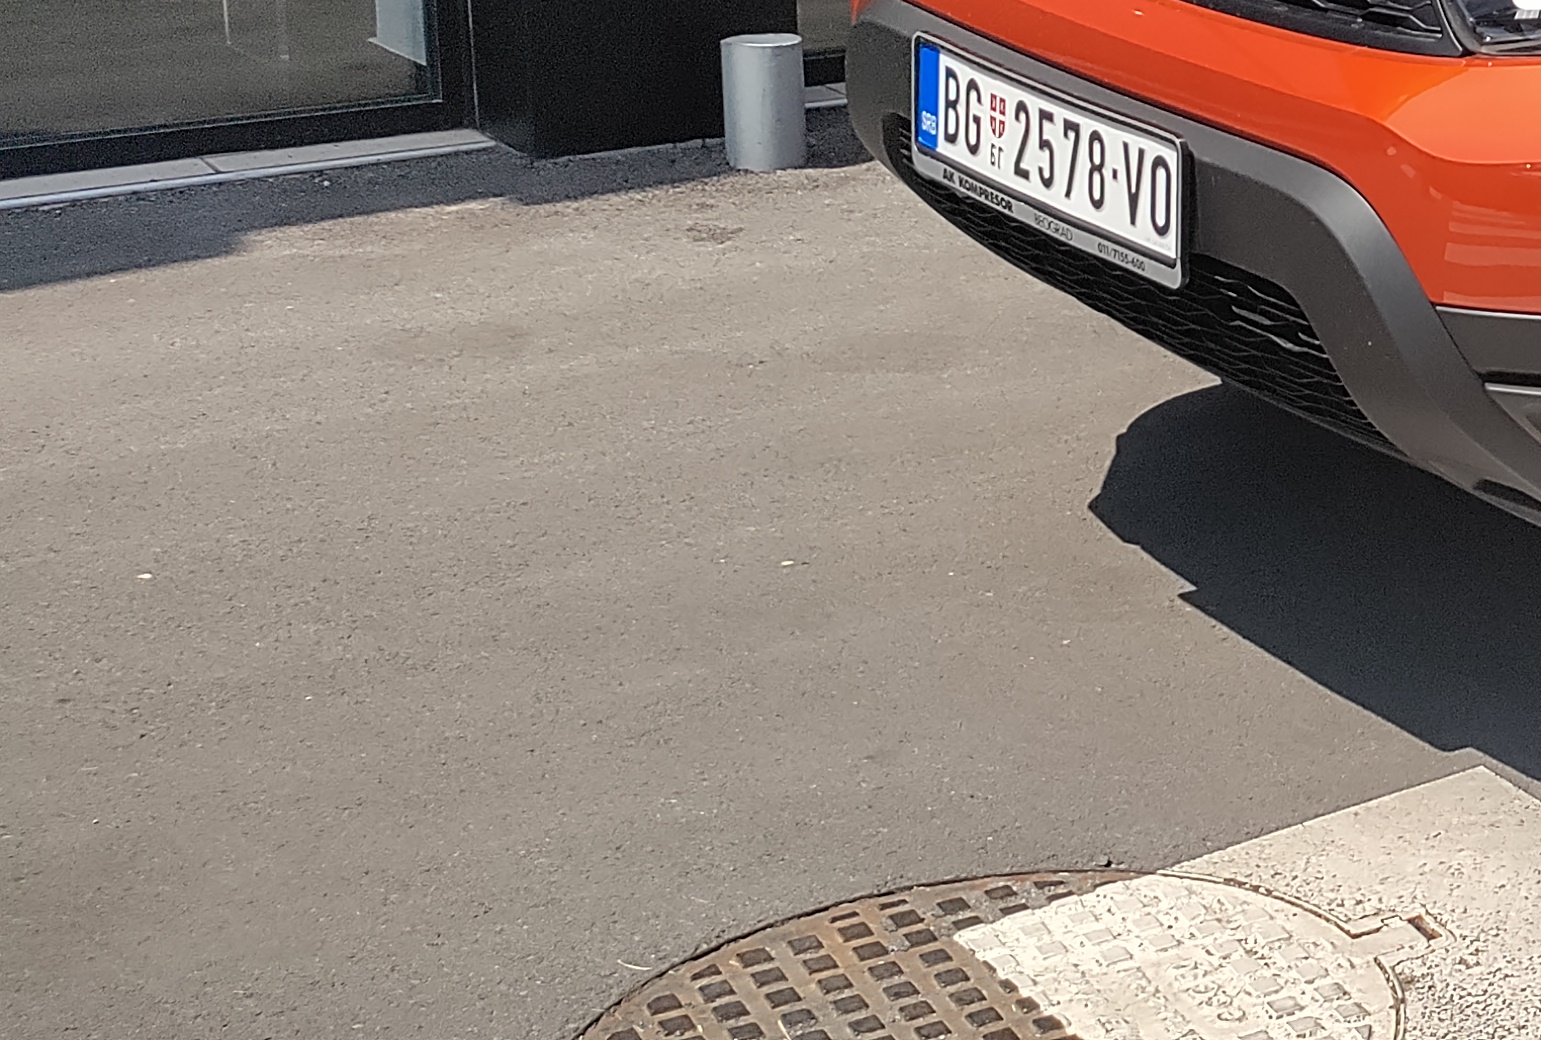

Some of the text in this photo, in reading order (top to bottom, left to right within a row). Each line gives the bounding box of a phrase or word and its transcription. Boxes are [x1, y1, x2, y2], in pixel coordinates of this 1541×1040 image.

[921, 110, 936, 136] SRB
[944, 65, 983, 156] BG
[942, 167, 955, 185] AK
[957, 172, 1014, 214] KOMPRESOR
[1033, 212, 1074, 242] BEOGRAD
